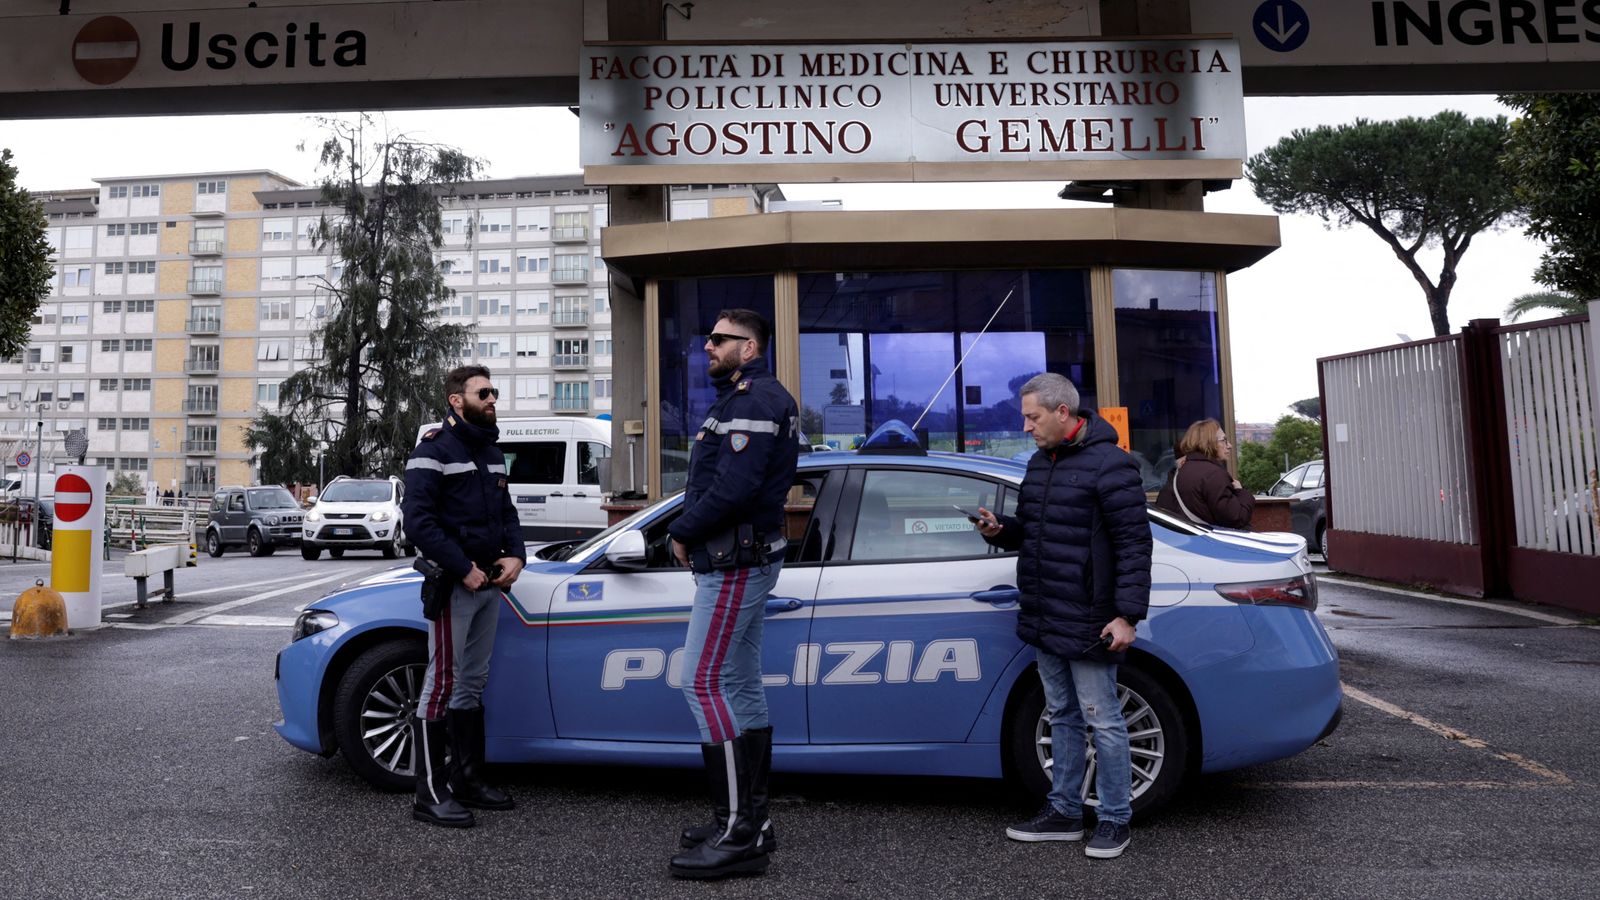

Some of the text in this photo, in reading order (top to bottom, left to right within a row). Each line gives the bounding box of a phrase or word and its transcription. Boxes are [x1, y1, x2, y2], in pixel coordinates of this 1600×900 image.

[161, 22, 367, 71] Uscita
[589, 49, 1231, 80] FACOLTÀ DI MEDICINA E CHIRURGIA
[643, 81, 1180, 110] POLICLINICO UNIVERSITARIO
[525, 428, 560, 436] ELECTRIC
